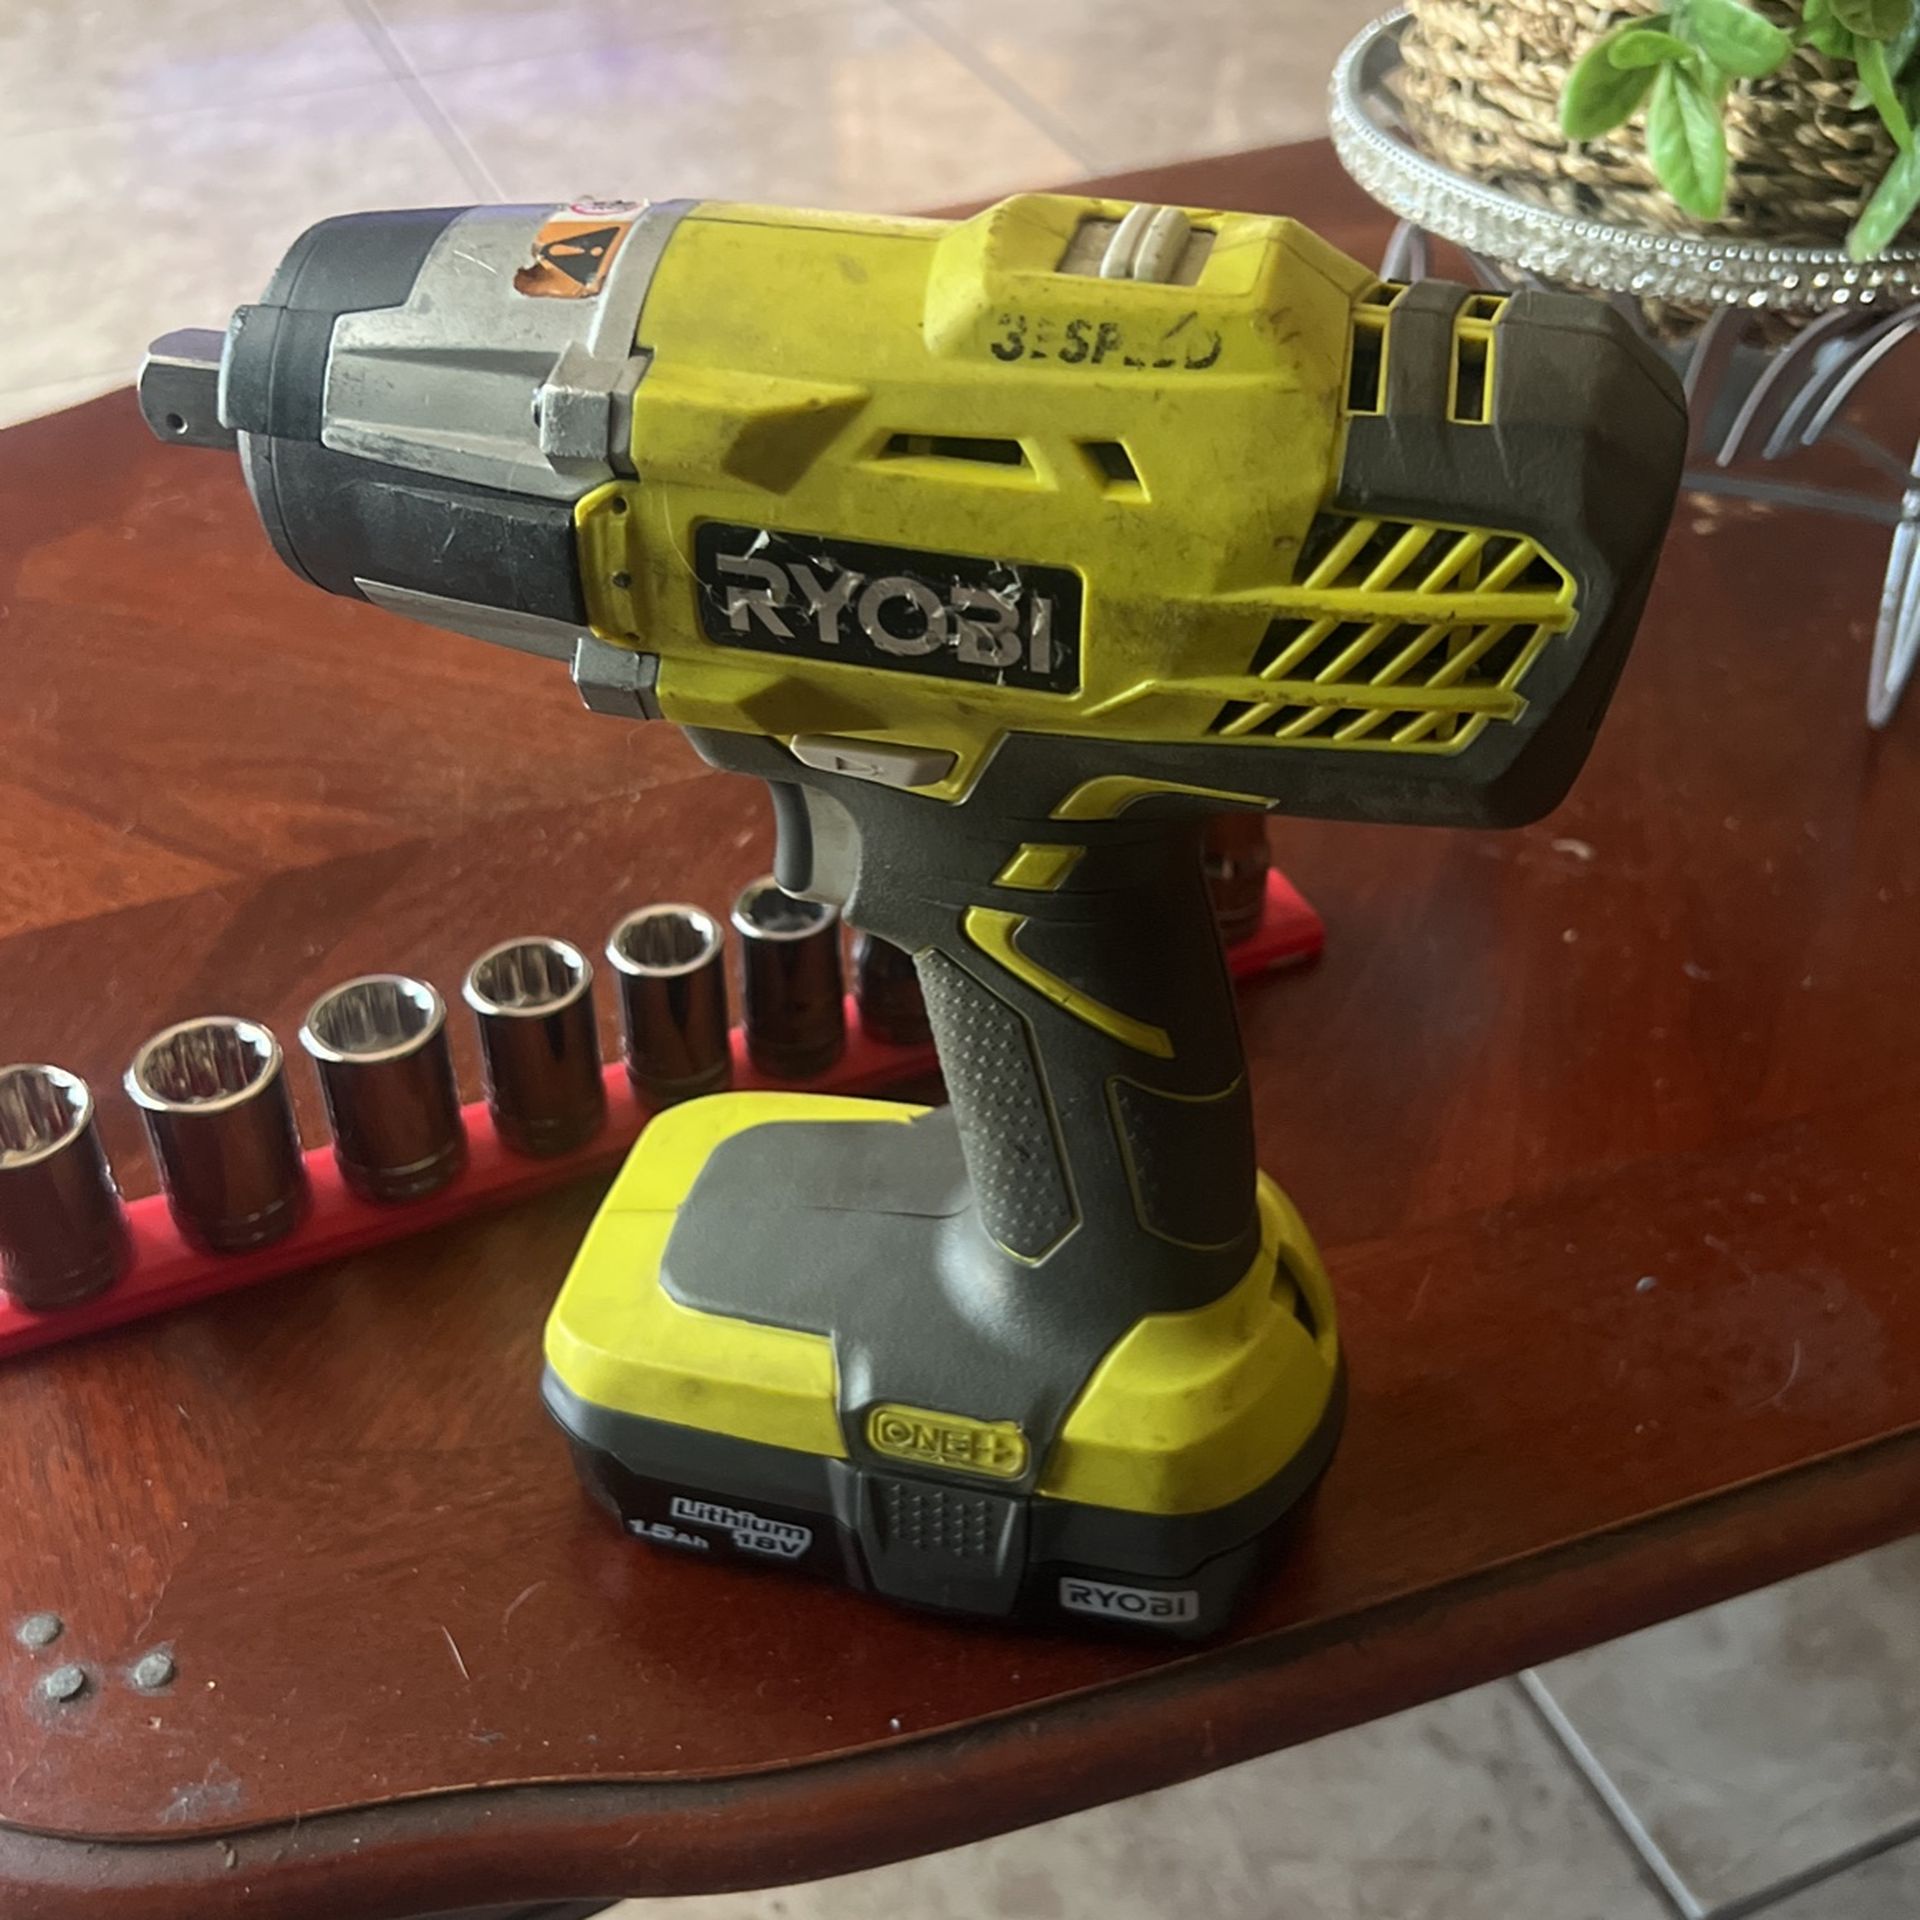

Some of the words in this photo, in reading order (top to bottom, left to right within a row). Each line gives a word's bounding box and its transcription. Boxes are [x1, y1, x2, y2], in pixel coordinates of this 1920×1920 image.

[715, 552, 1052, 674] RYOBI
[676, 1500, 805, 1541] Lithium
[737, 1532, 801, 1555] 18V
[1066, 1583, 1186, 1616] RYOBI
